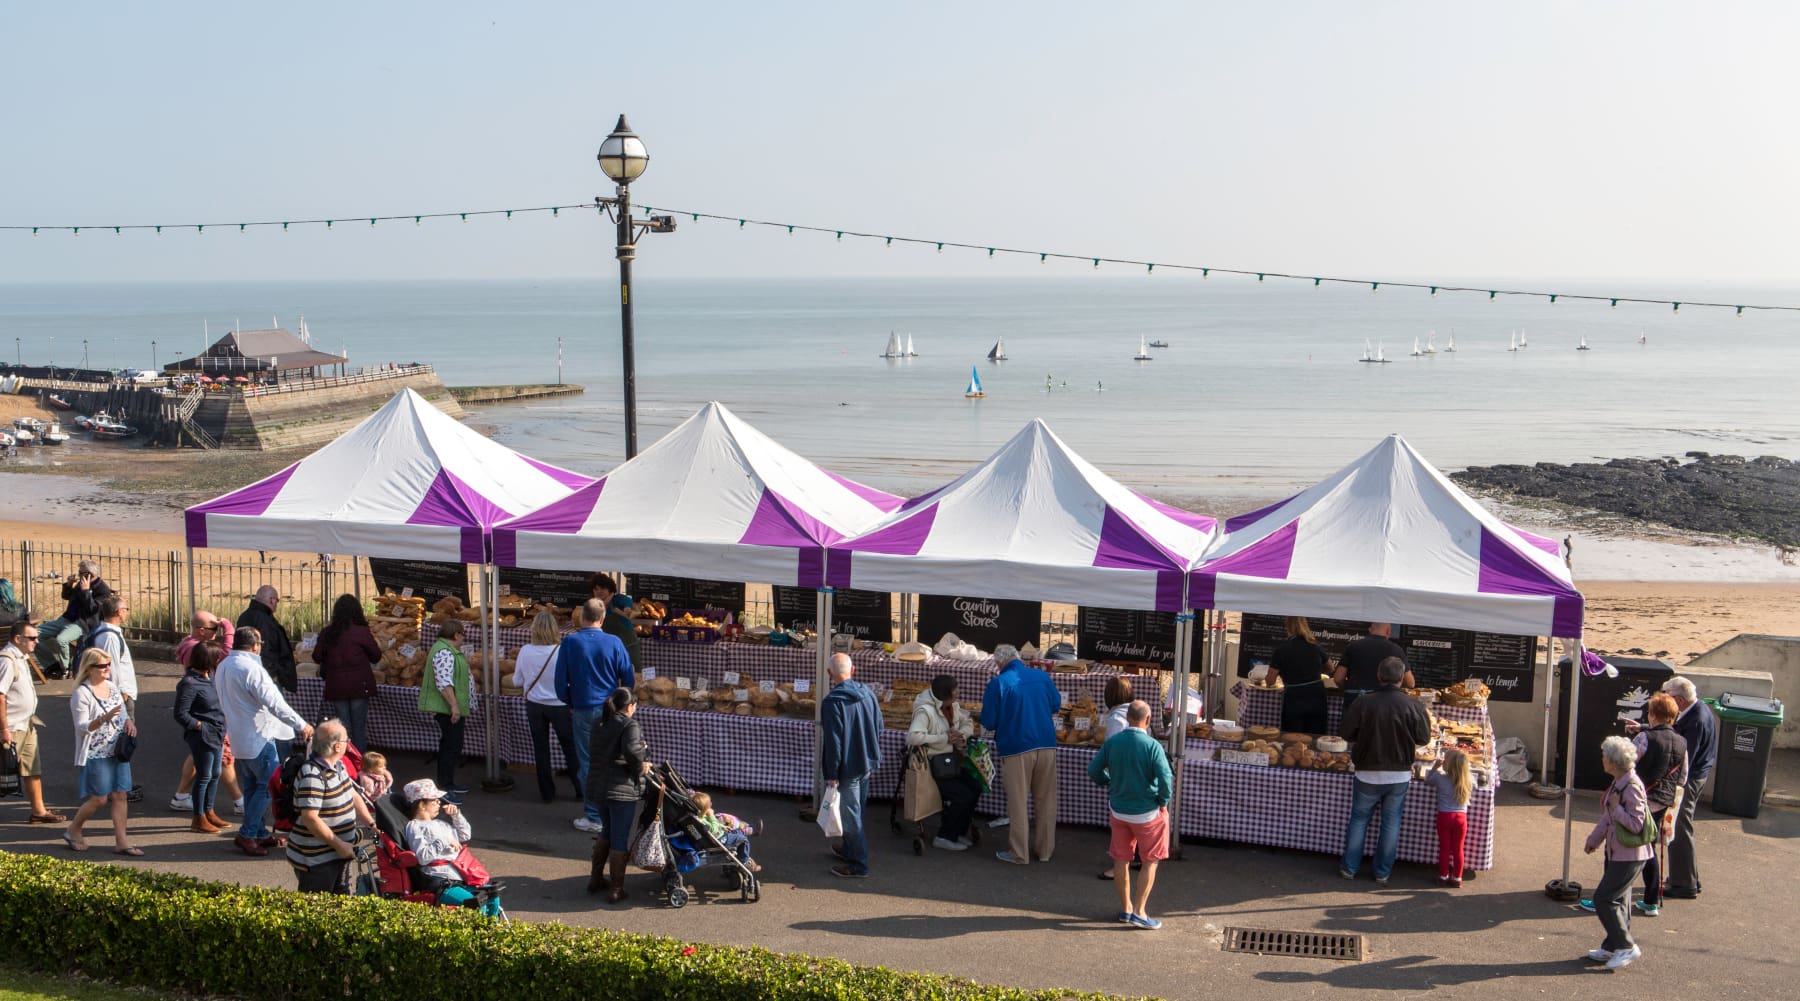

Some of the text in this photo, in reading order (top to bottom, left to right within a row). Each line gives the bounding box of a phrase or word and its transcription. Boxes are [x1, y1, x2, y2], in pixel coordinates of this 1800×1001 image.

[953, 597, 1000, 619] Country
[961, 611, 999, 628] Stores
[1096, 640, 1122, 656] Freshly
[1486, 674, 1495, 686] to
